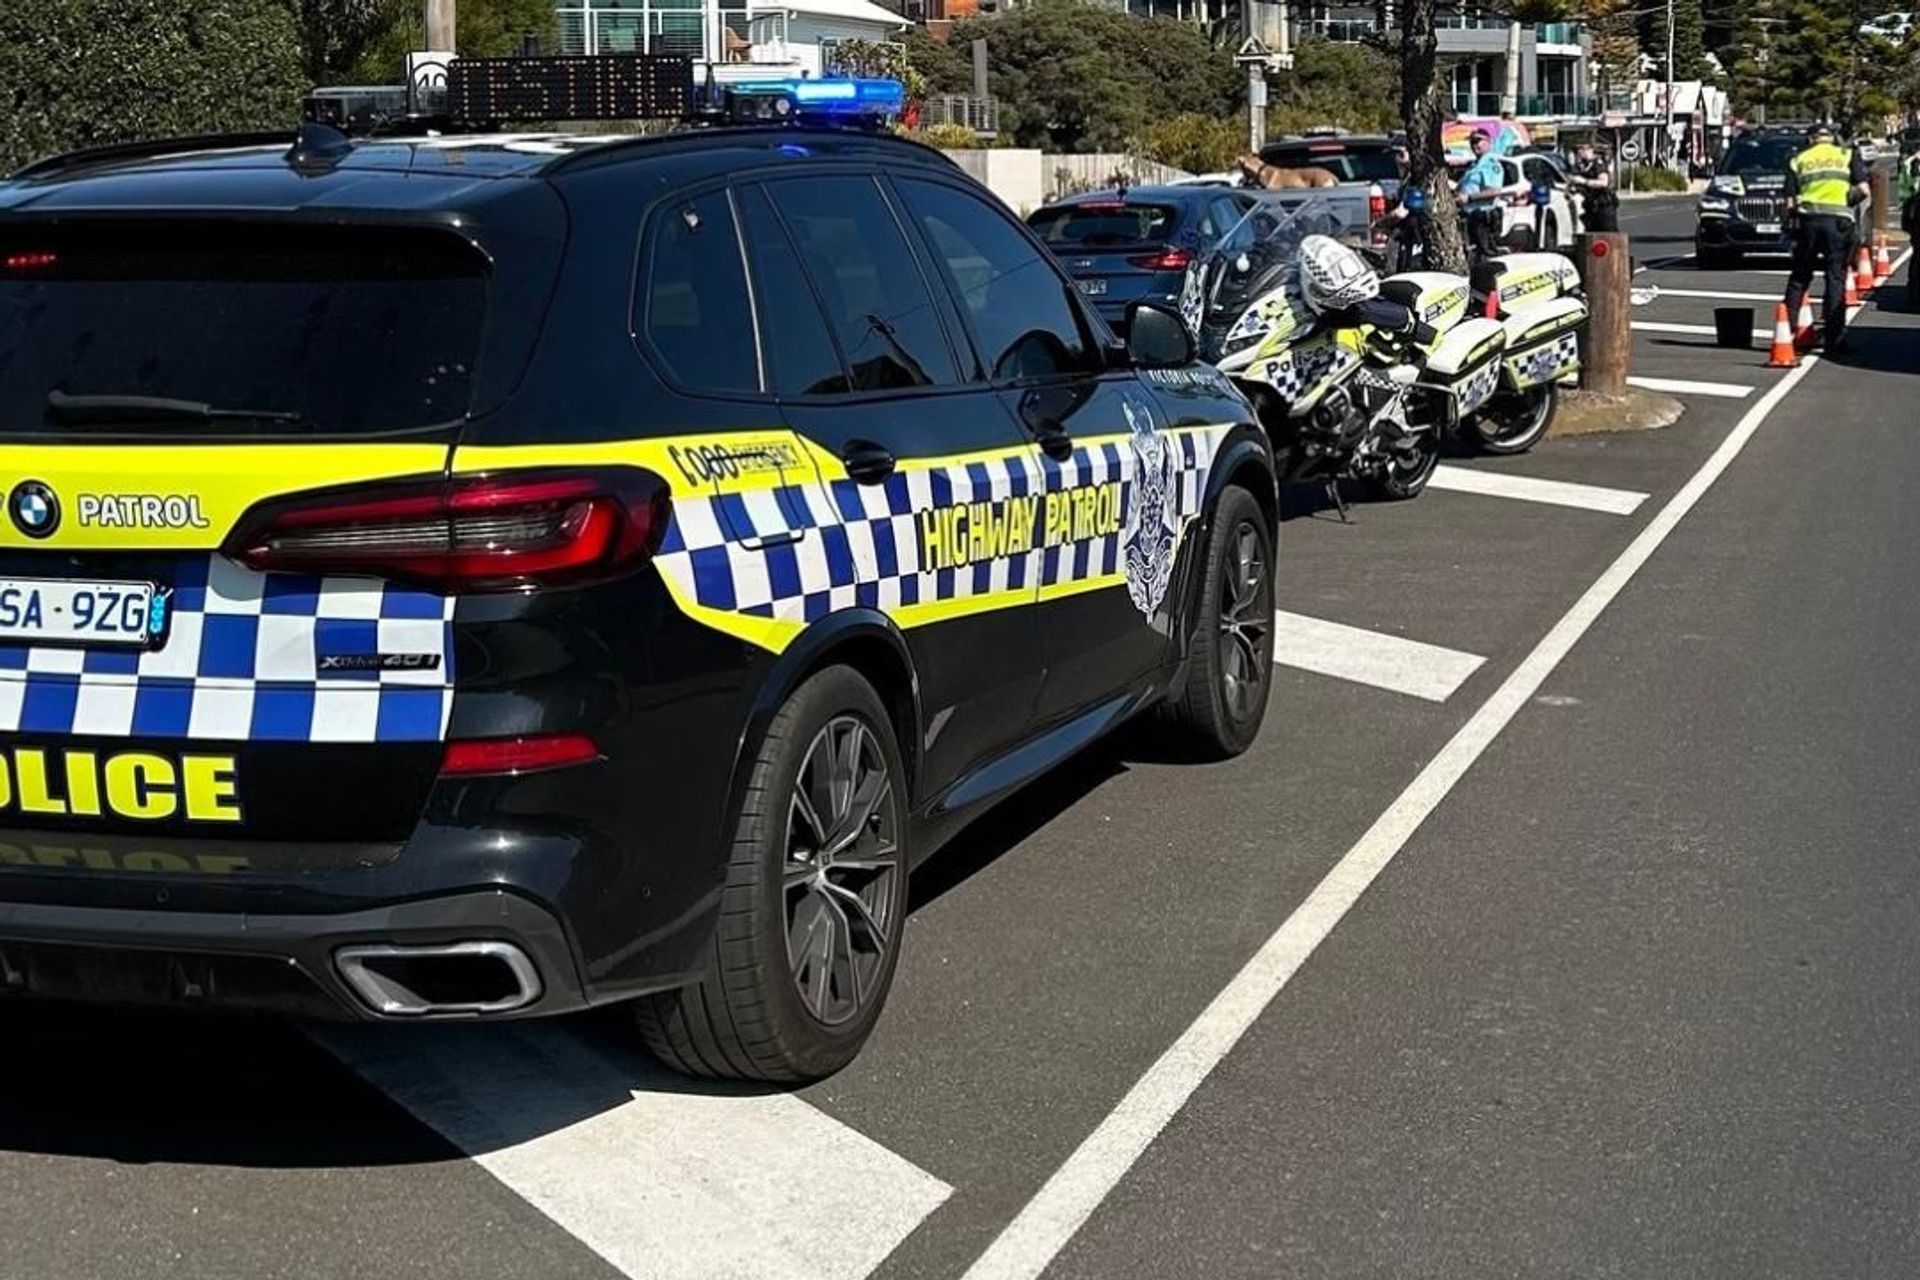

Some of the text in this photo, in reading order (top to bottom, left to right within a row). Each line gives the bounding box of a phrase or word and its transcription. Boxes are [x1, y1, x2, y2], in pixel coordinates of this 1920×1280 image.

[450, 58, 684, 118] TESTING
[78, 494, 210, 528] PATROL
[922, 482, 1121, 573] HIGHWAY PATROL
